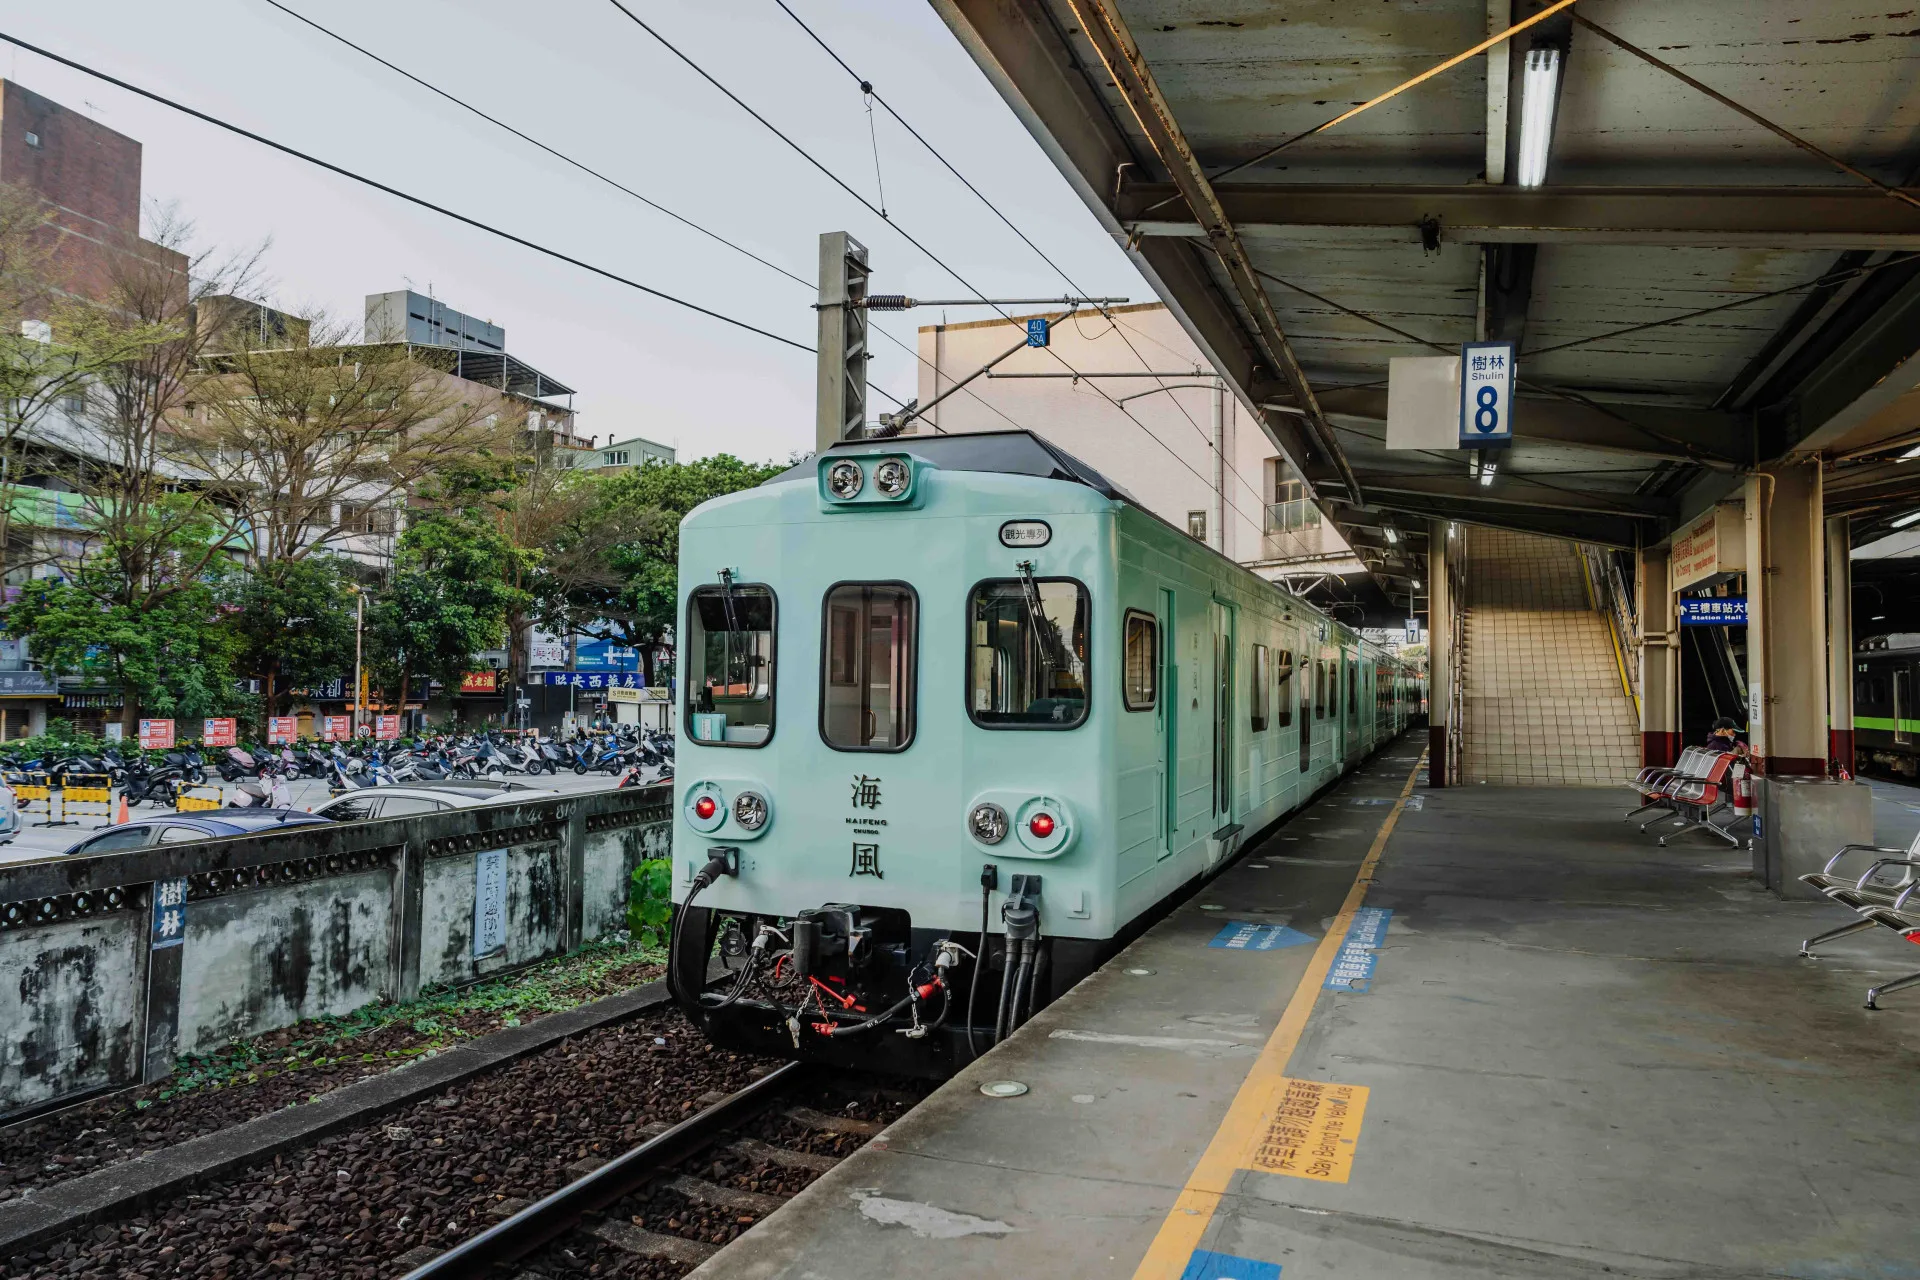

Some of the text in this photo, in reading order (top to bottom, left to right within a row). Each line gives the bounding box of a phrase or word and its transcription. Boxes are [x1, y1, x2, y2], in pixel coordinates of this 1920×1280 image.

[1031, 320, 1042, 331] 40
[1471, 355, 1504, 371] 樹林
[1471, 372, 1504, 381] Shulin
[1475, 386, 1498, 433] 8
[1005, 529, 1047, 540] 觀光專列
[1689, 602, 1748, 614] 三樓車站大
[1409, 629, 1416, 641] 7
[360, 727, 370, 736] 30
[845, 818, 888, 826] HAIFENG
[159, 881, 181, 936] 樹林
[1327, 1086, 1353, 1099] Line
[1253, 1081, 1324, 1170] 候車時請勿超越黃線
[1321, 1120, 1344, 1132] the
[1312, 1132, 1340, 1158] Behind
[1305, 1158, 1339, 1177] Stay
